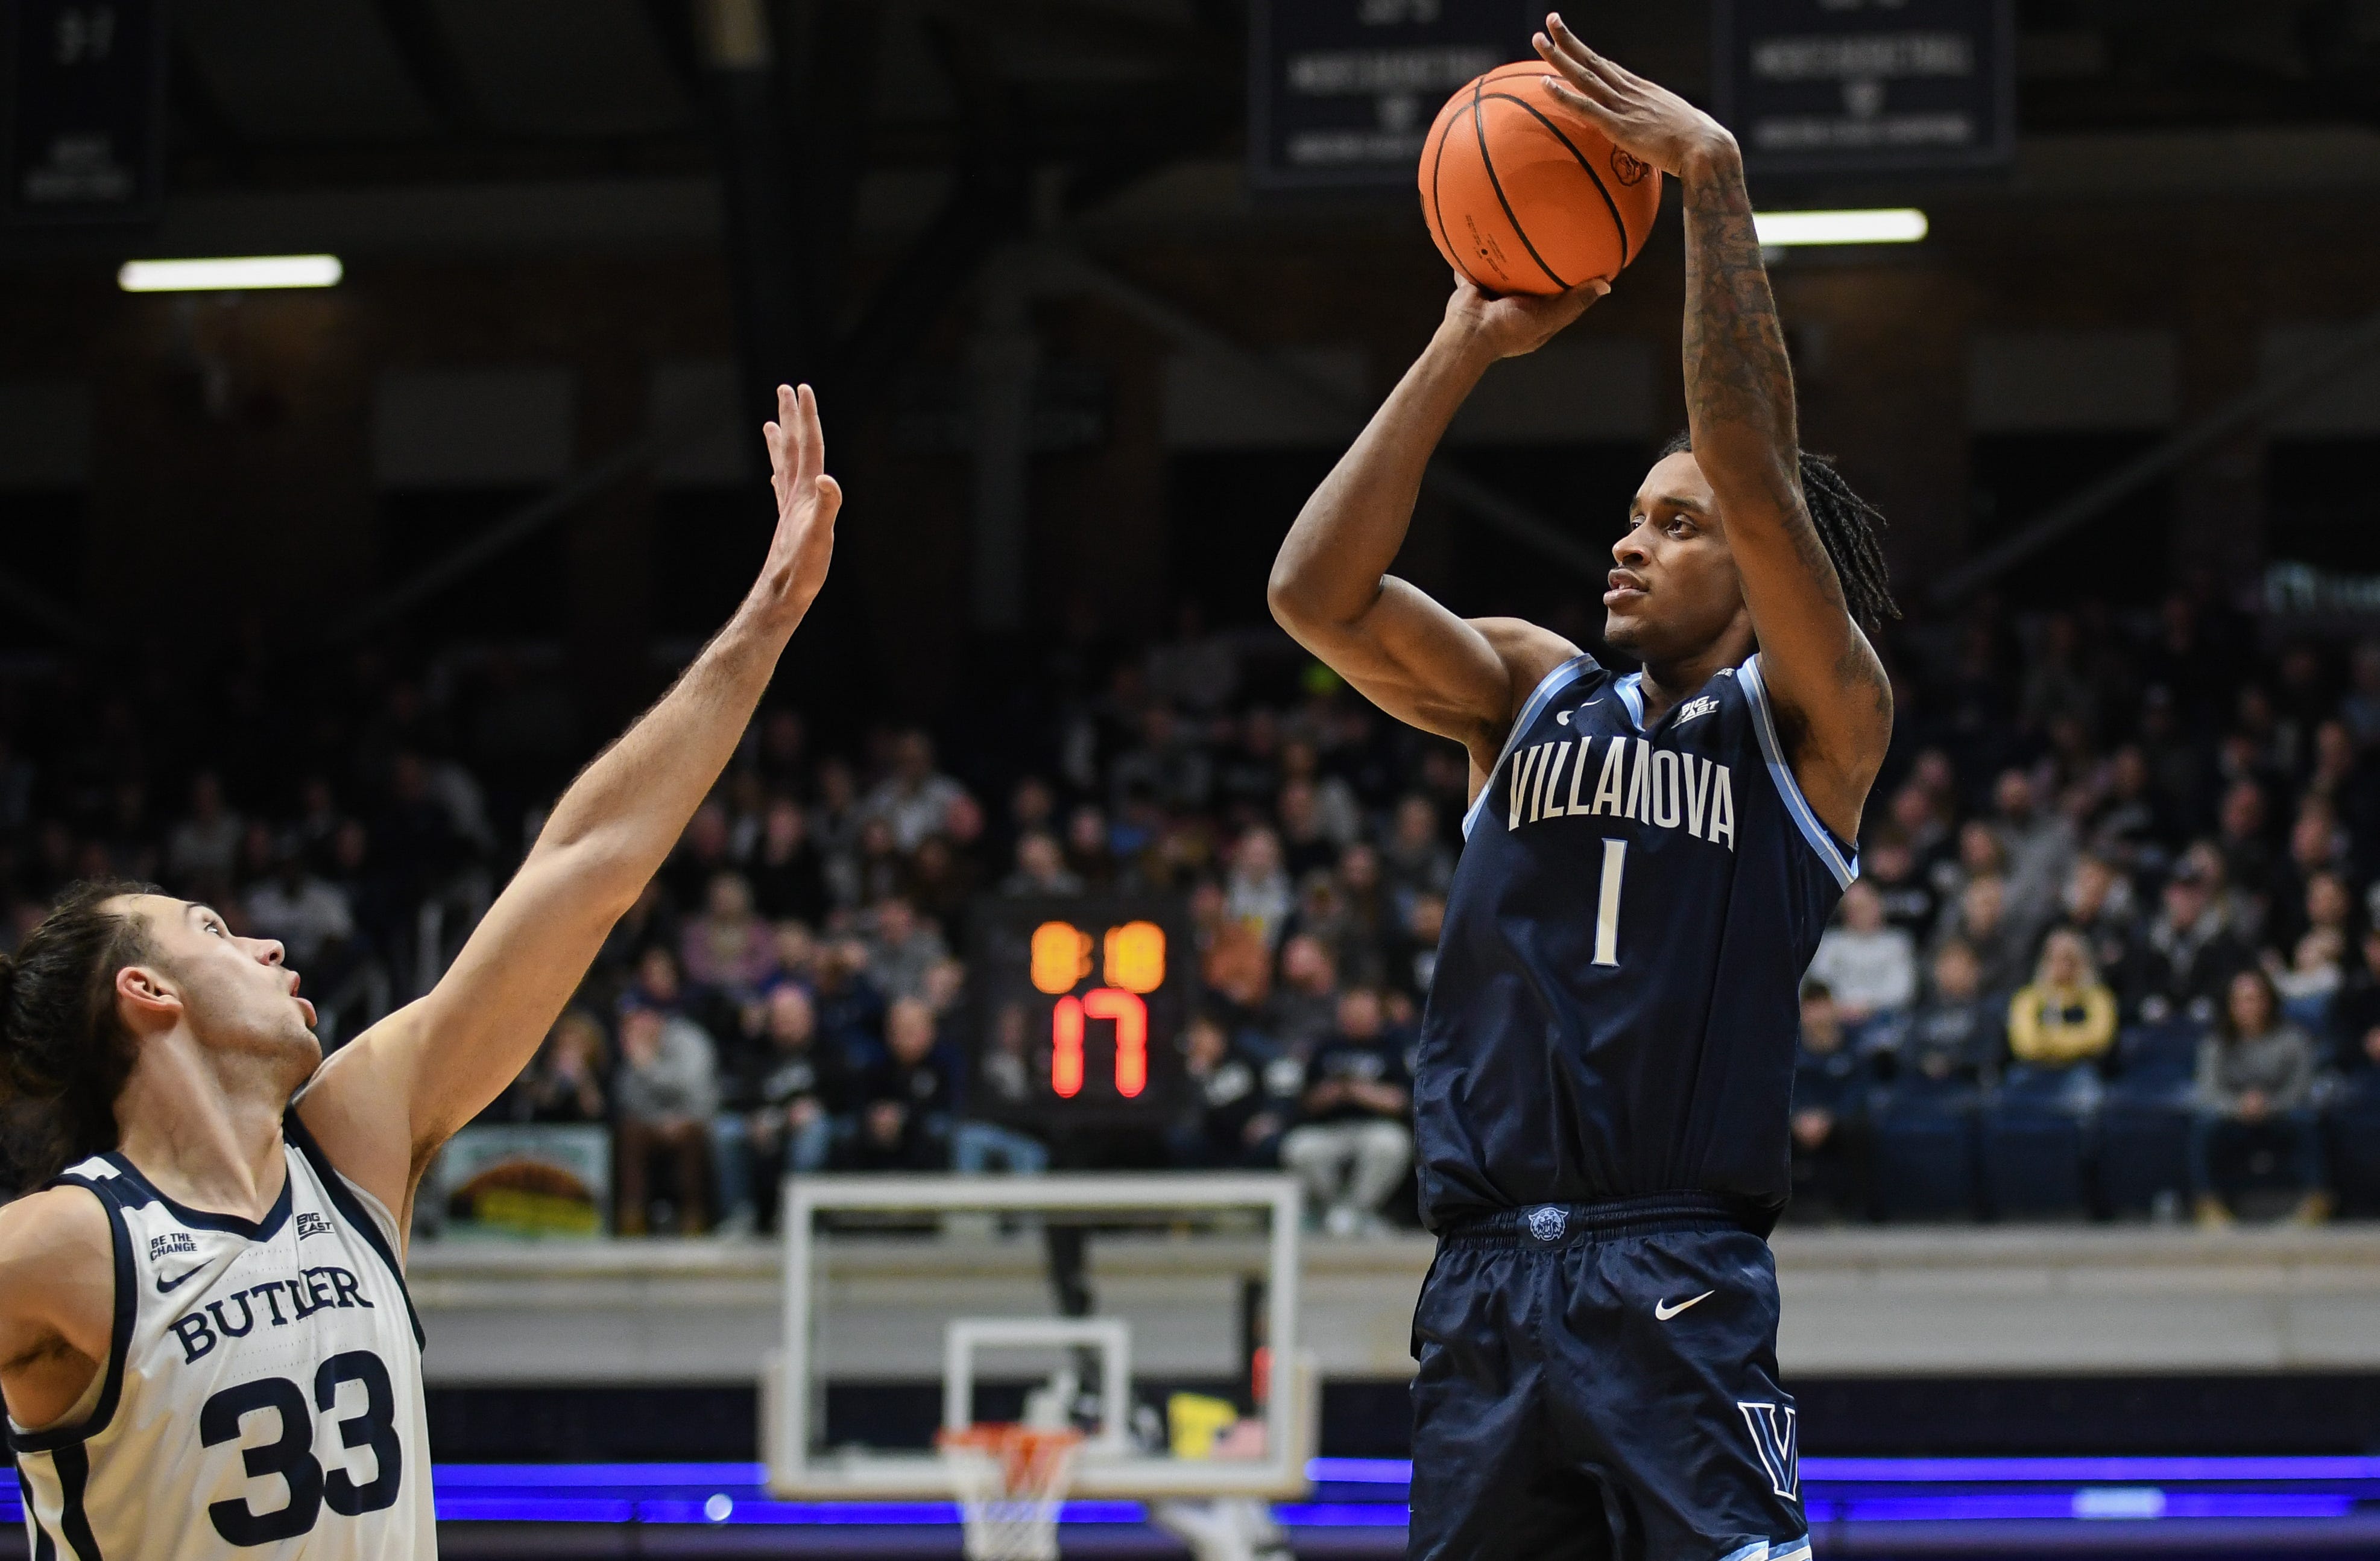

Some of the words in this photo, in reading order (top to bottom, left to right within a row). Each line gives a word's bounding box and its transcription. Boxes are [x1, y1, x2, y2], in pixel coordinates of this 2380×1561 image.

[1681, 695, 1710, 717] BIG
[1509, 736, 1734, 853] VILLANOVA
[1591, 837, 1627, 967] 1
[1052, 987, 1147, 1098] 17
[150, 1243, 198, 1261] CHANGE
[151, 1235, 166, 1249] BE
[169, 1232, 193, 1243] THE
[296, 1212, 320, 1226] BIG
[297, 1222, 333, 1236] EAST
[168, 1267, 375, 1366] BUTLER
[200, 1349, 402, 1547] 33
[1737, 1401, 1798, 1502] V
